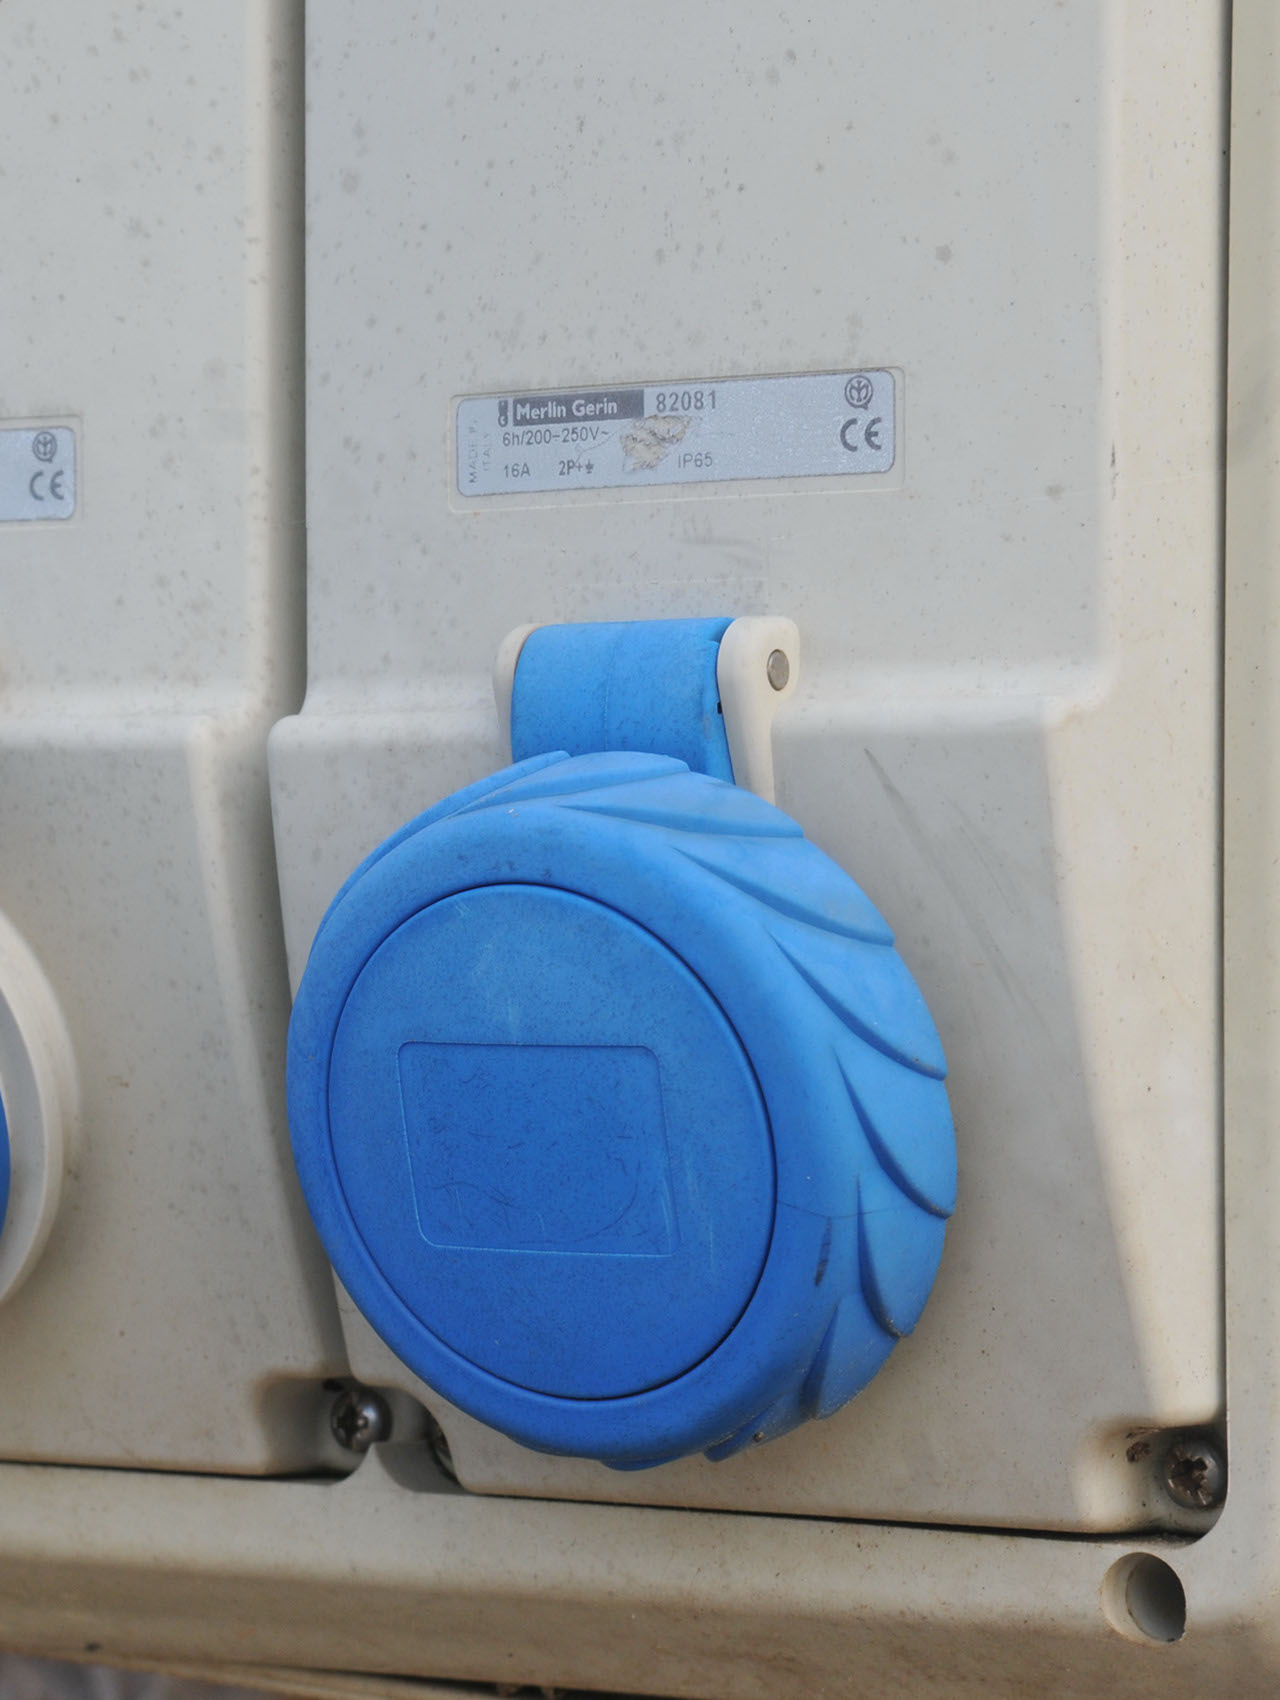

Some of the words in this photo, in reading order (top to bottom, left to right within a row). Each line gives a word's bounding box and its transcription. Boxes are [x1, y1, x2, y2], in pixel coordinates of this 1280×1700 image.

[516, 401, 566, 420] Merlin
[571, 398, 618, 416] Gerin
[656, 389, 716, 413] 82081
[840, 416, 882, 452] CE
[504, 462, 531, 478] 16A
[678, 452, 713, 469] IP65
[29, 469, 65, 501] CE
